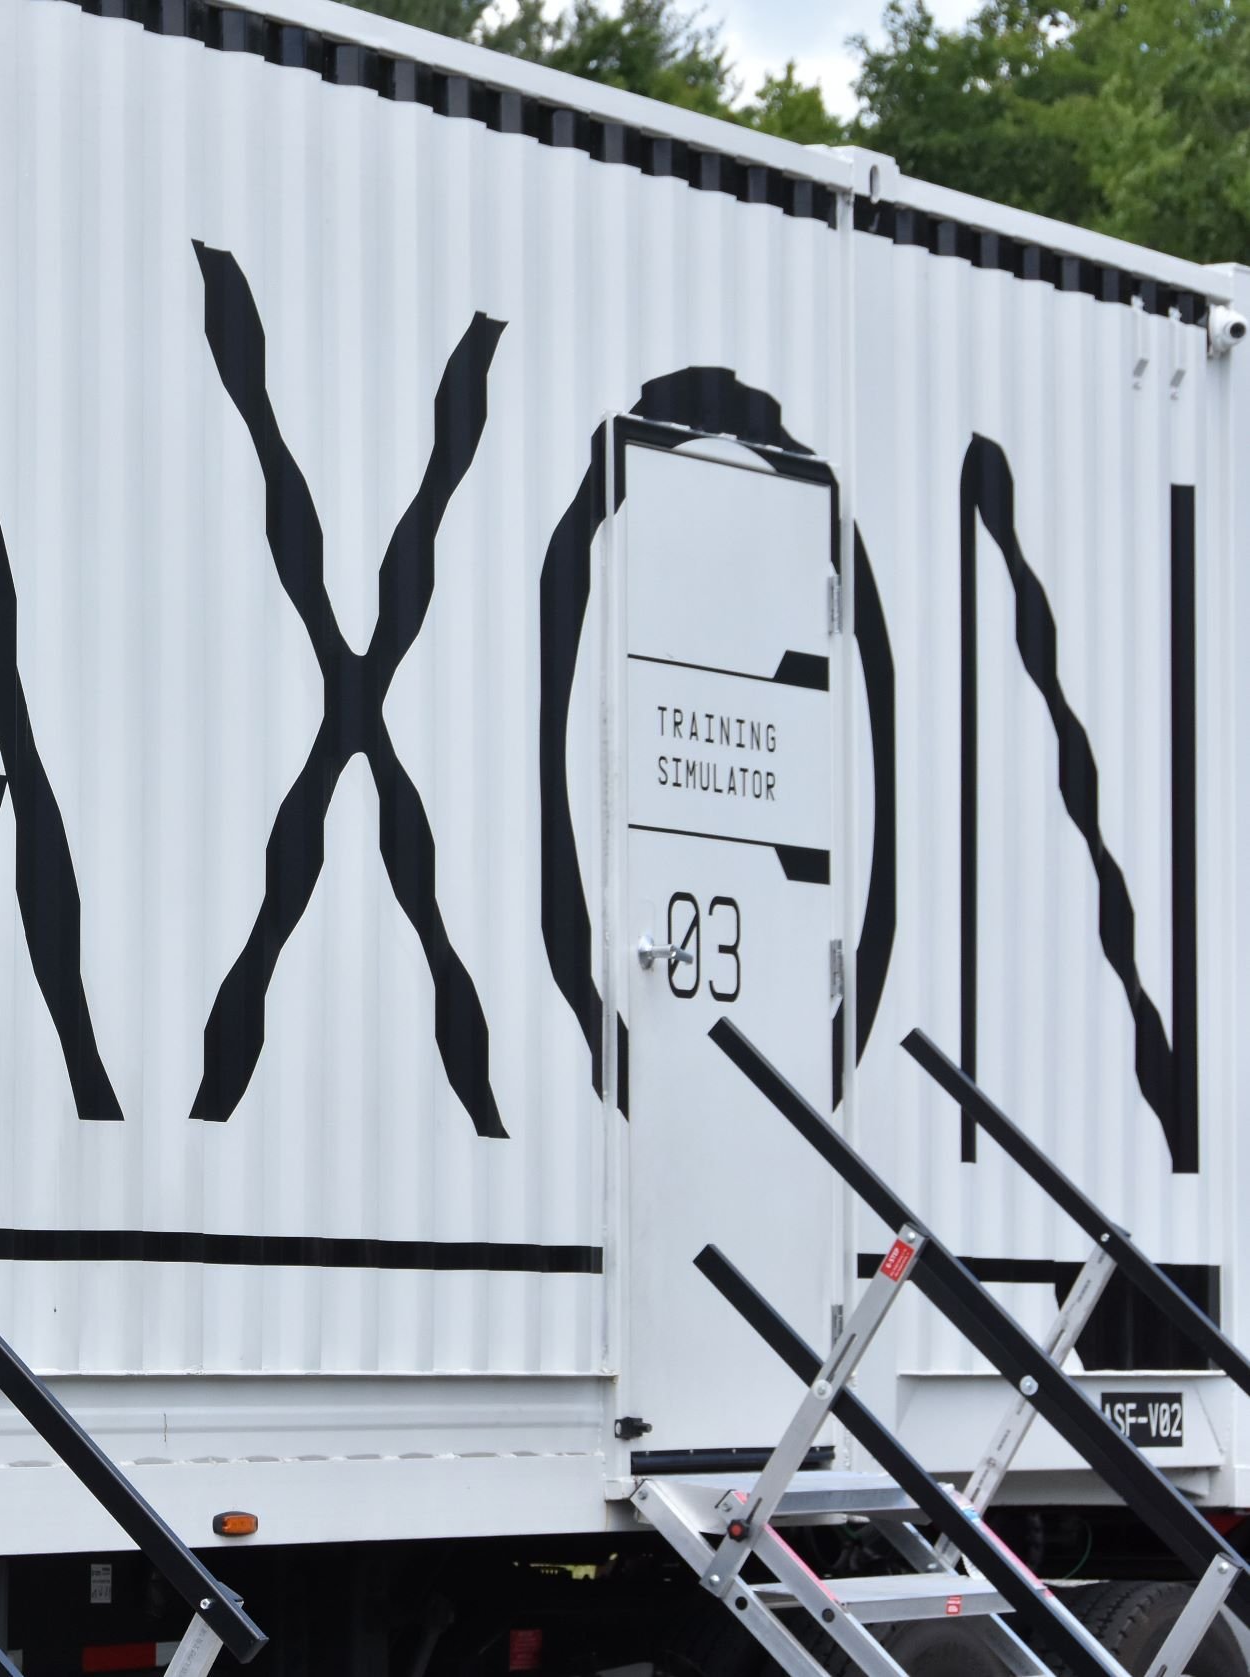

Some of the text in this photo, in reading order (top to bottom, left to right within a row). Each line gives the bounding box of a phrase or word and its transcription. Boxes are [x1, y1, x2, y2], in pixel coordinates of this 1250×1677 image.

[657, 705, 777, 753] TRAINING
[658, 755, 777, 801] SIMULATOR
[667, 891, 742, 1003] 03
